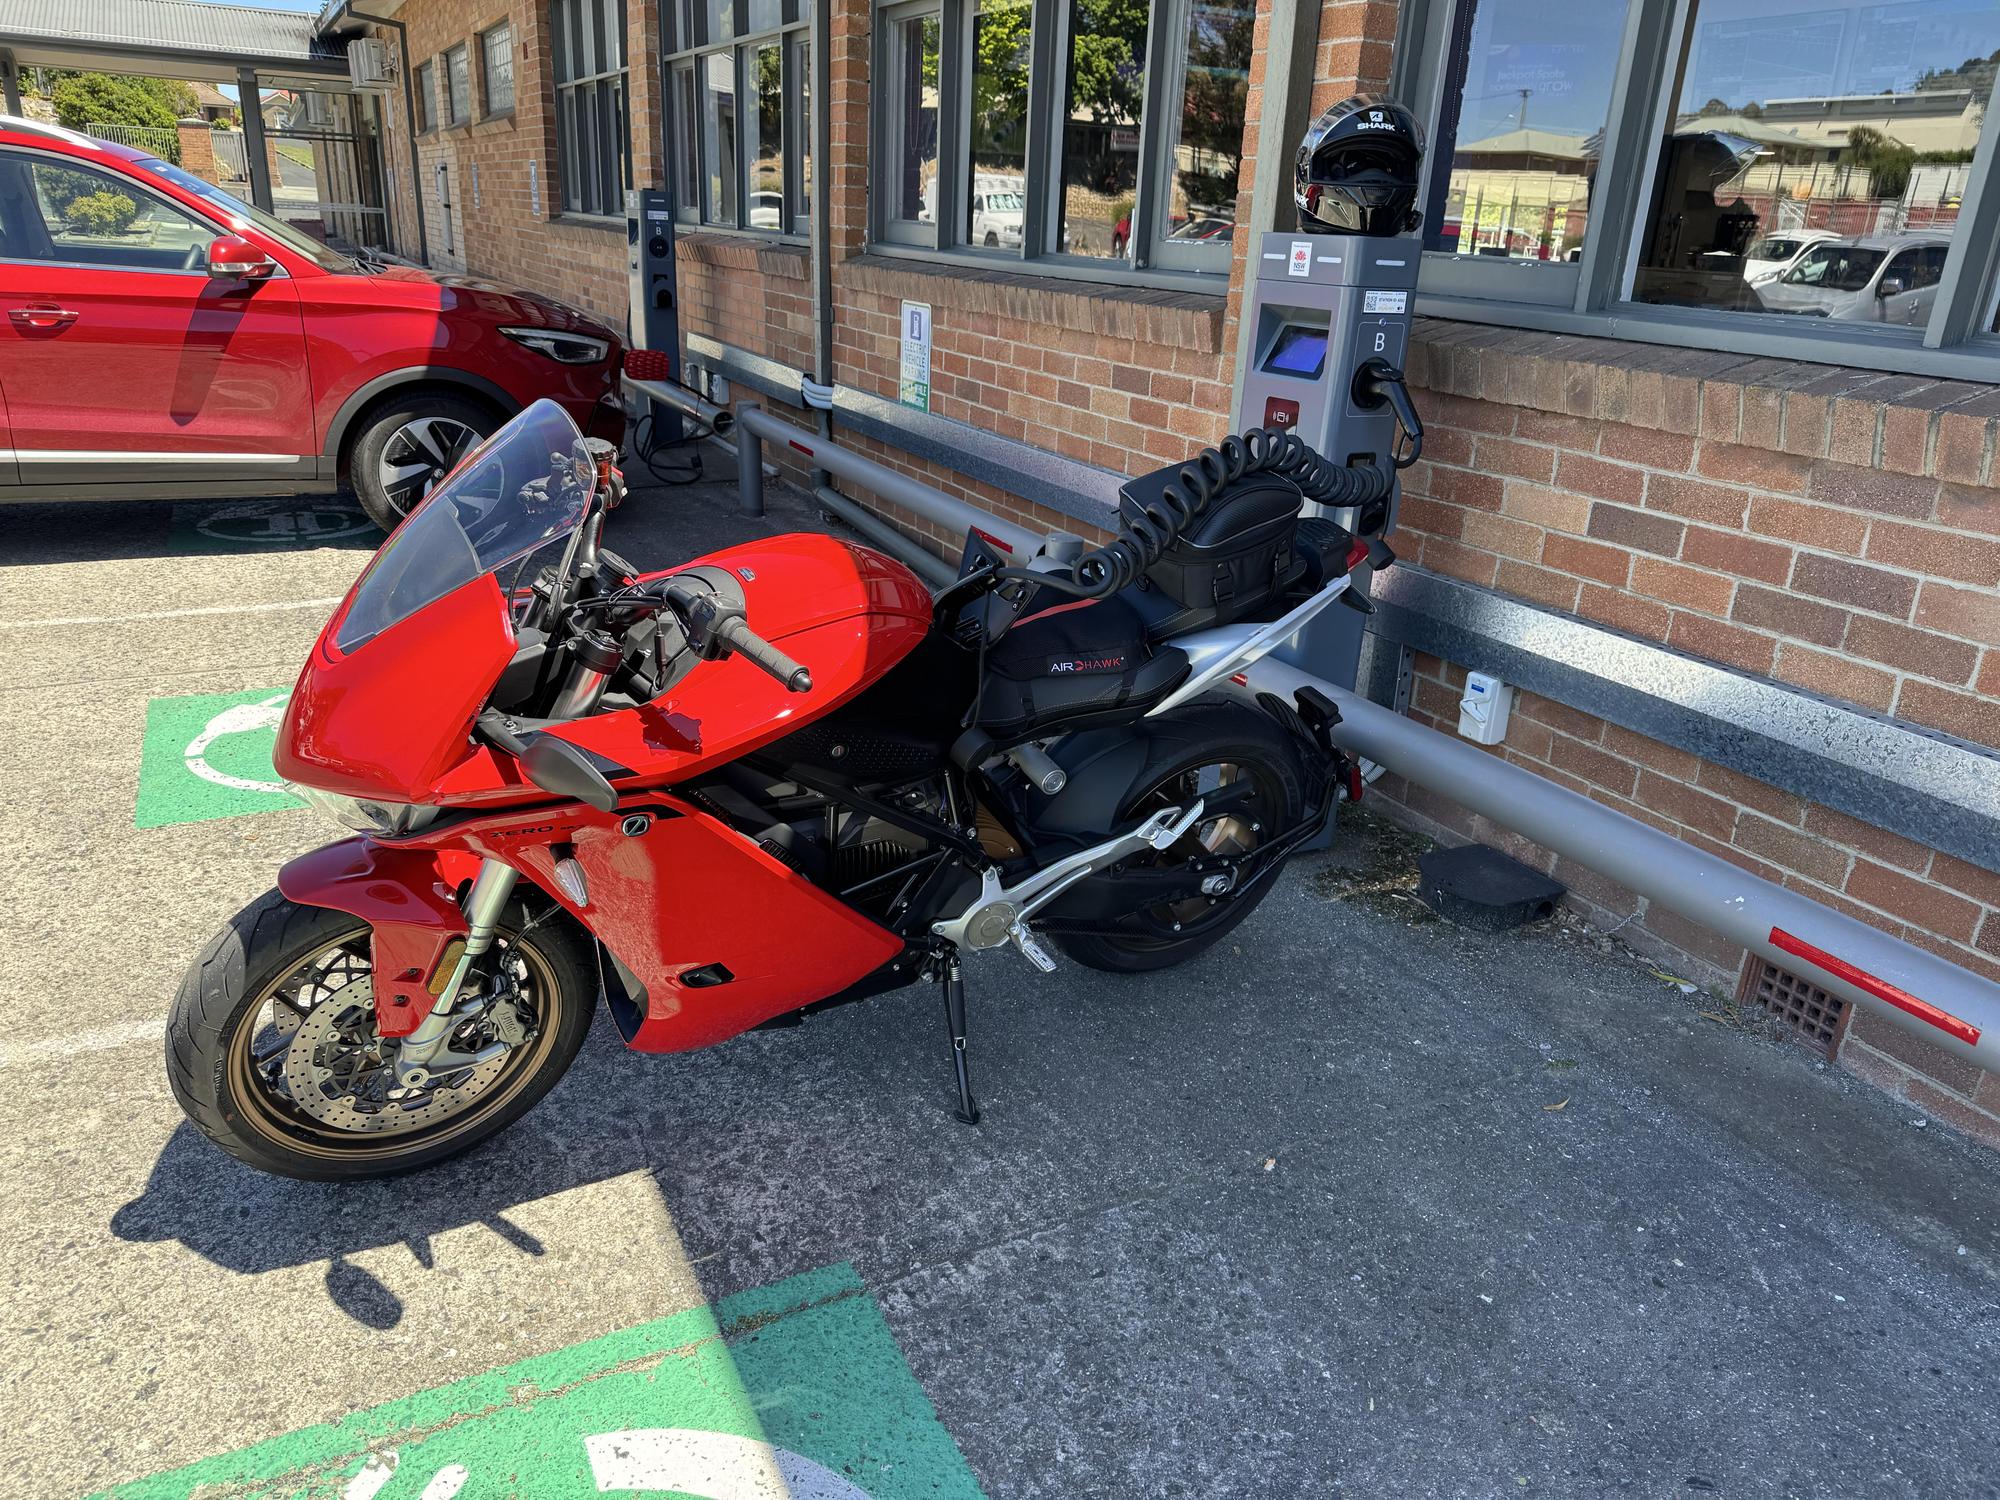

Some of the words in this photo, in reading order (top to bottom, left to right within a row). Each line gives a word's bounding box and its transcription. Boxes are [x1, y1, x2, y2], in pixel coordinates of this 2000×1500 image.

[1357, 122, 1396, 131] SHARK
[656, 227, 662, 235] B
[1293, 262, 1306, 270] NSW
[904, 340, 927, 357] ELECTRIC
[1374, 332, 1386, 351] B
[905, 353, 926, 369] VEHICLE
[904, 364, 926, 381] PARKING
[490, 825, 554, 838] ZERO
